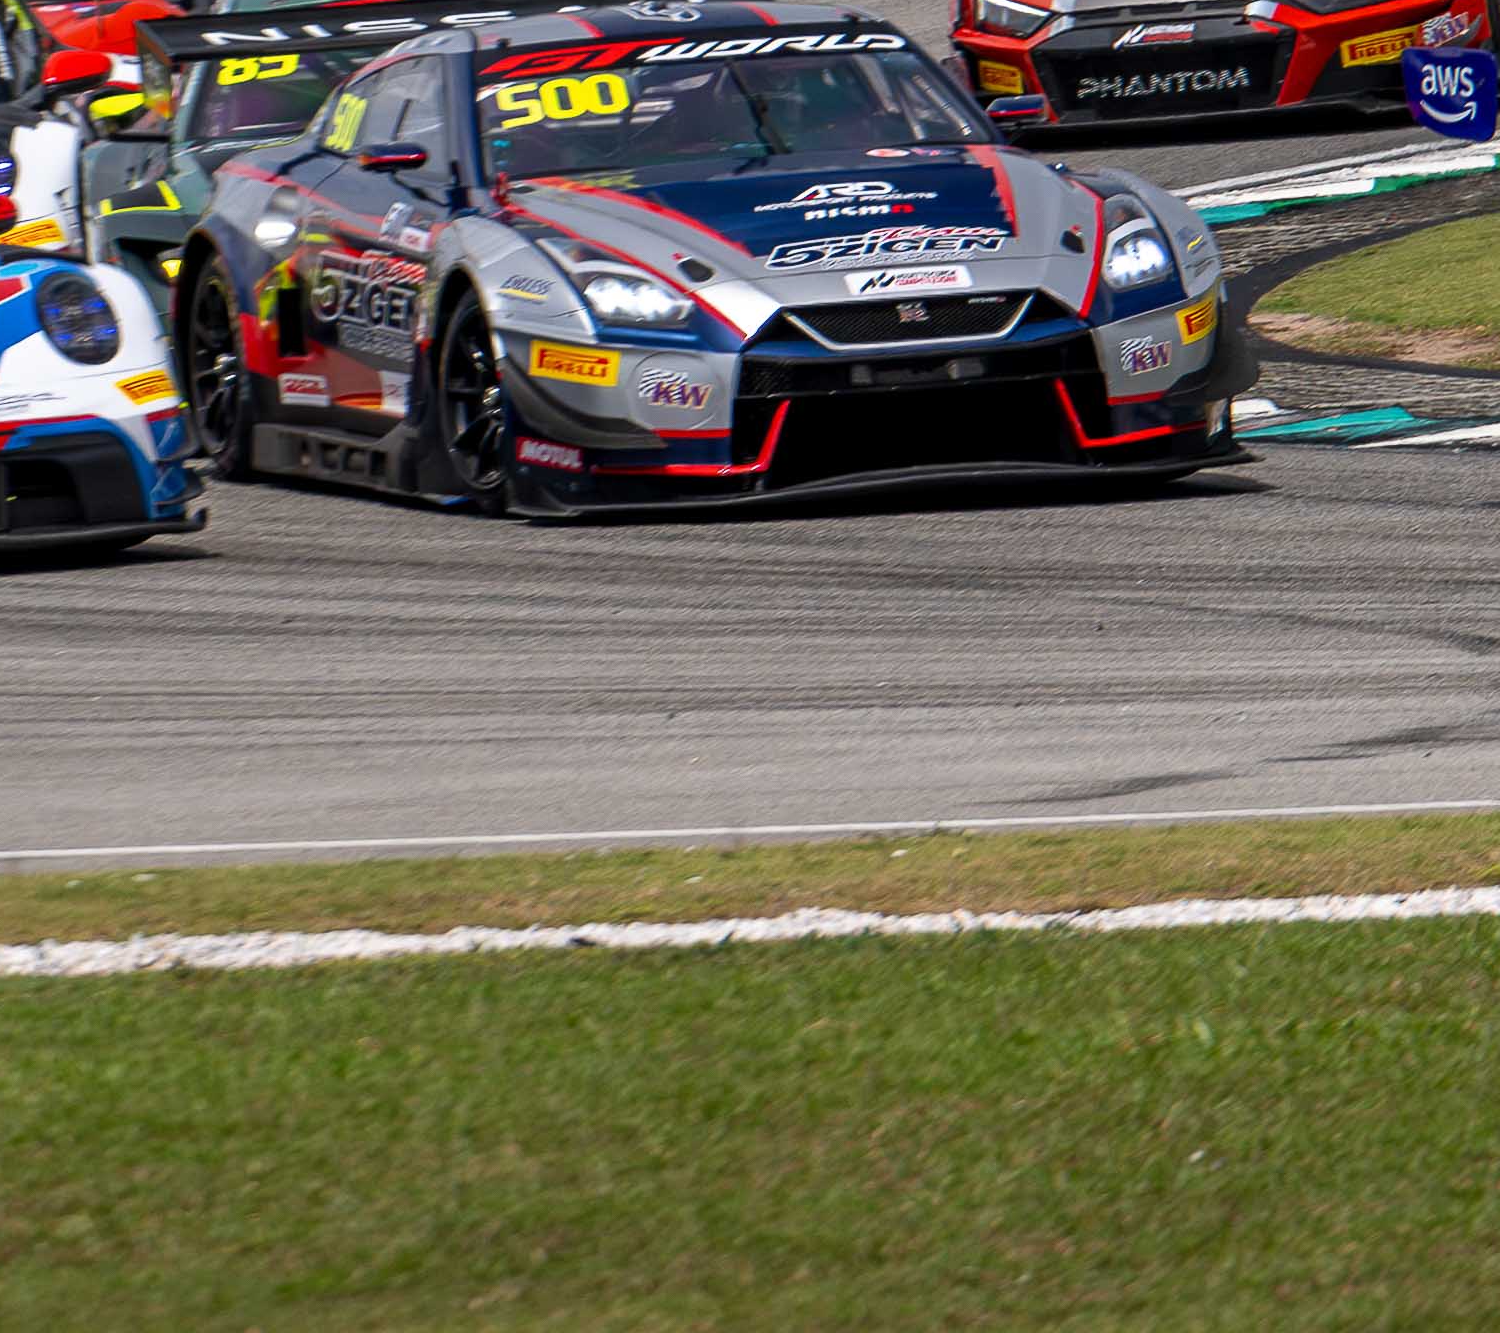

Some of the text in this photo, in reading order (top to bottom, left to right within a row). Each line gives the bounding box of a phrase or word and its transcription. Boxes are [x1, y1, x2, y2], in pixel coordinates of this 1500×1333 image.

[637, 34, 907, 62] WORLD
[1076, 66, 1251, 100] PHANTOM
[1420, 63, 1476, 97] aws
[496, 73, 631, 130] 500
[764, 235, 1007, 270] 5ZIGEN
[537, 348, 609, 380] PIRELLI
[519, 438, 583, 468] MOTUL
